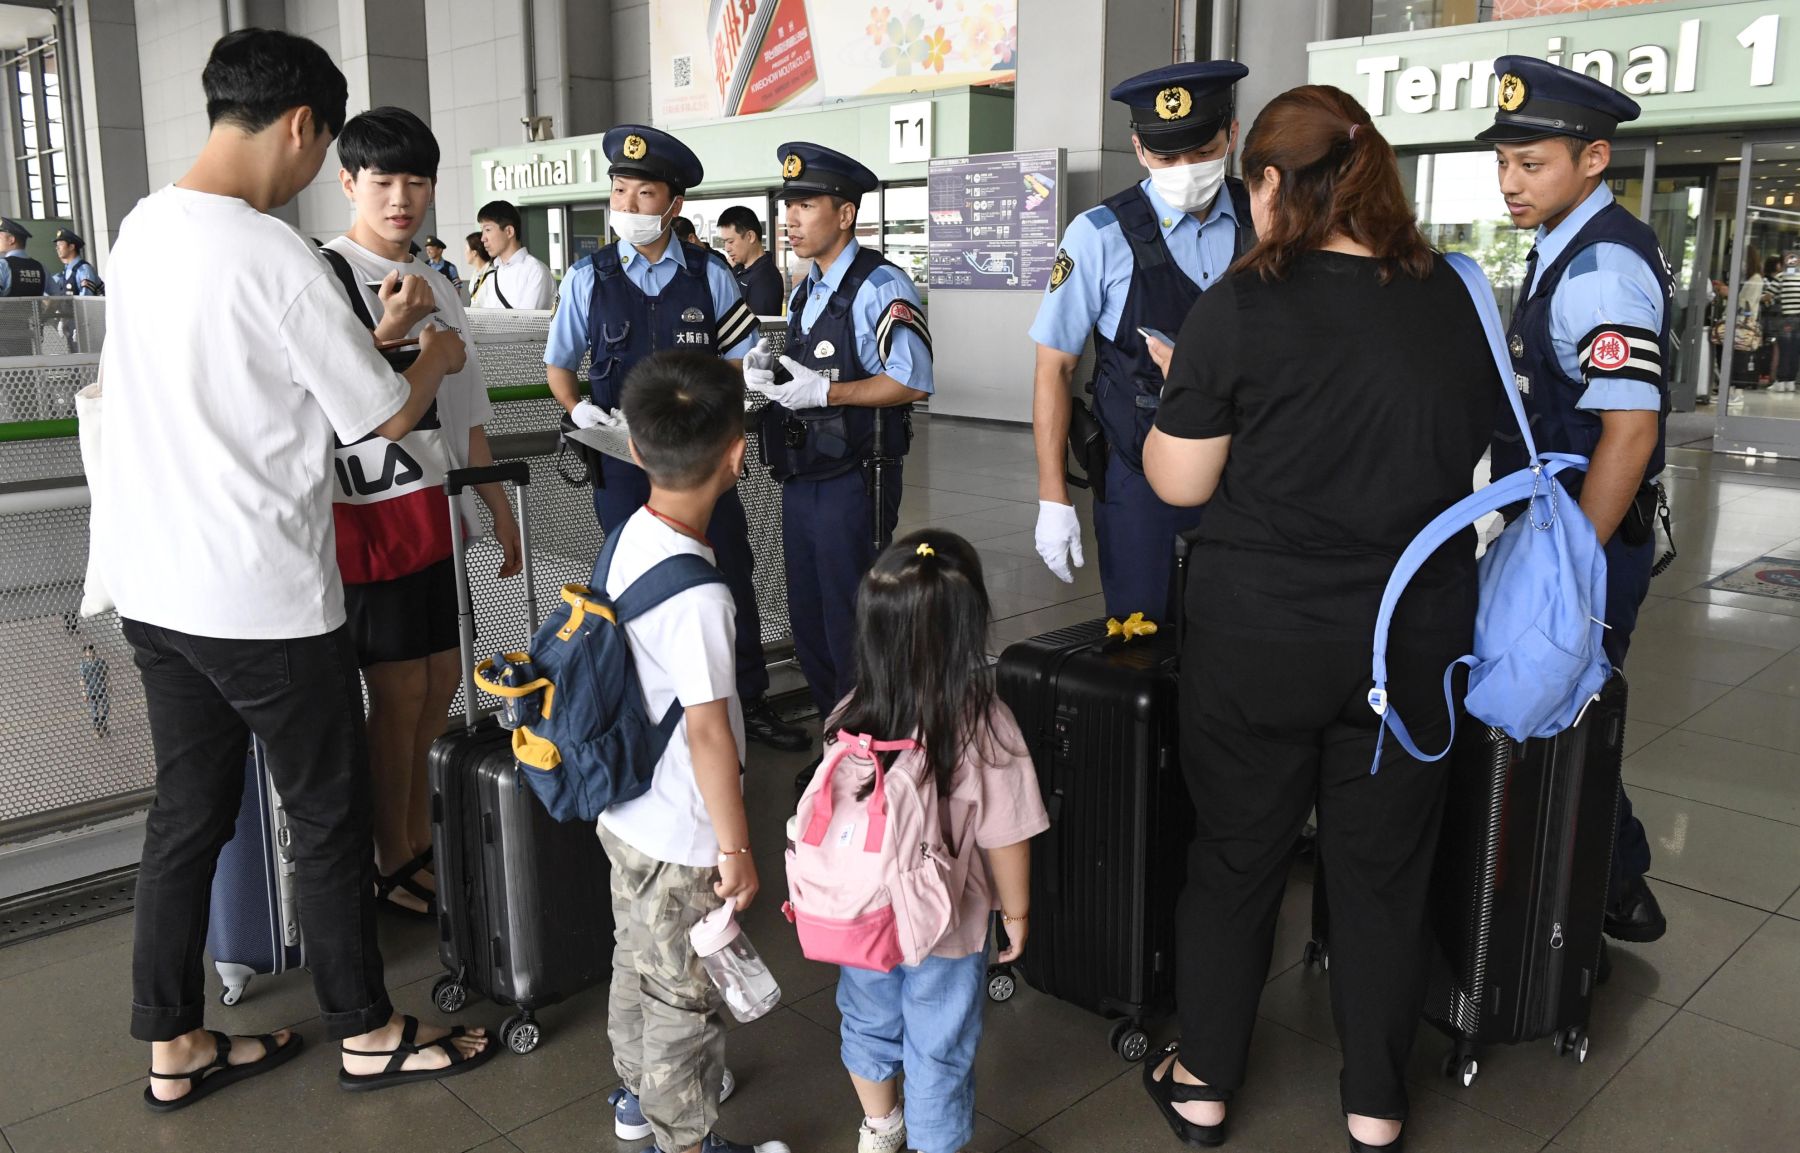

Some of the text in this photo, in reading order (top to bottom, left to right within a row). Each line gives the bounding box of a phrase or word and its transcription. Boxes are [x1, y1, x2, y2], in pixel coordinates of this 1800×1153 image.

[1736, 14, 1780, 87] 1
[894, 118, 924, 149] T1
[481, 148, 594, 192] Terminal 1
[1597, 338, 1620, 361] 機
[335, 442, 424, 497] ILA
